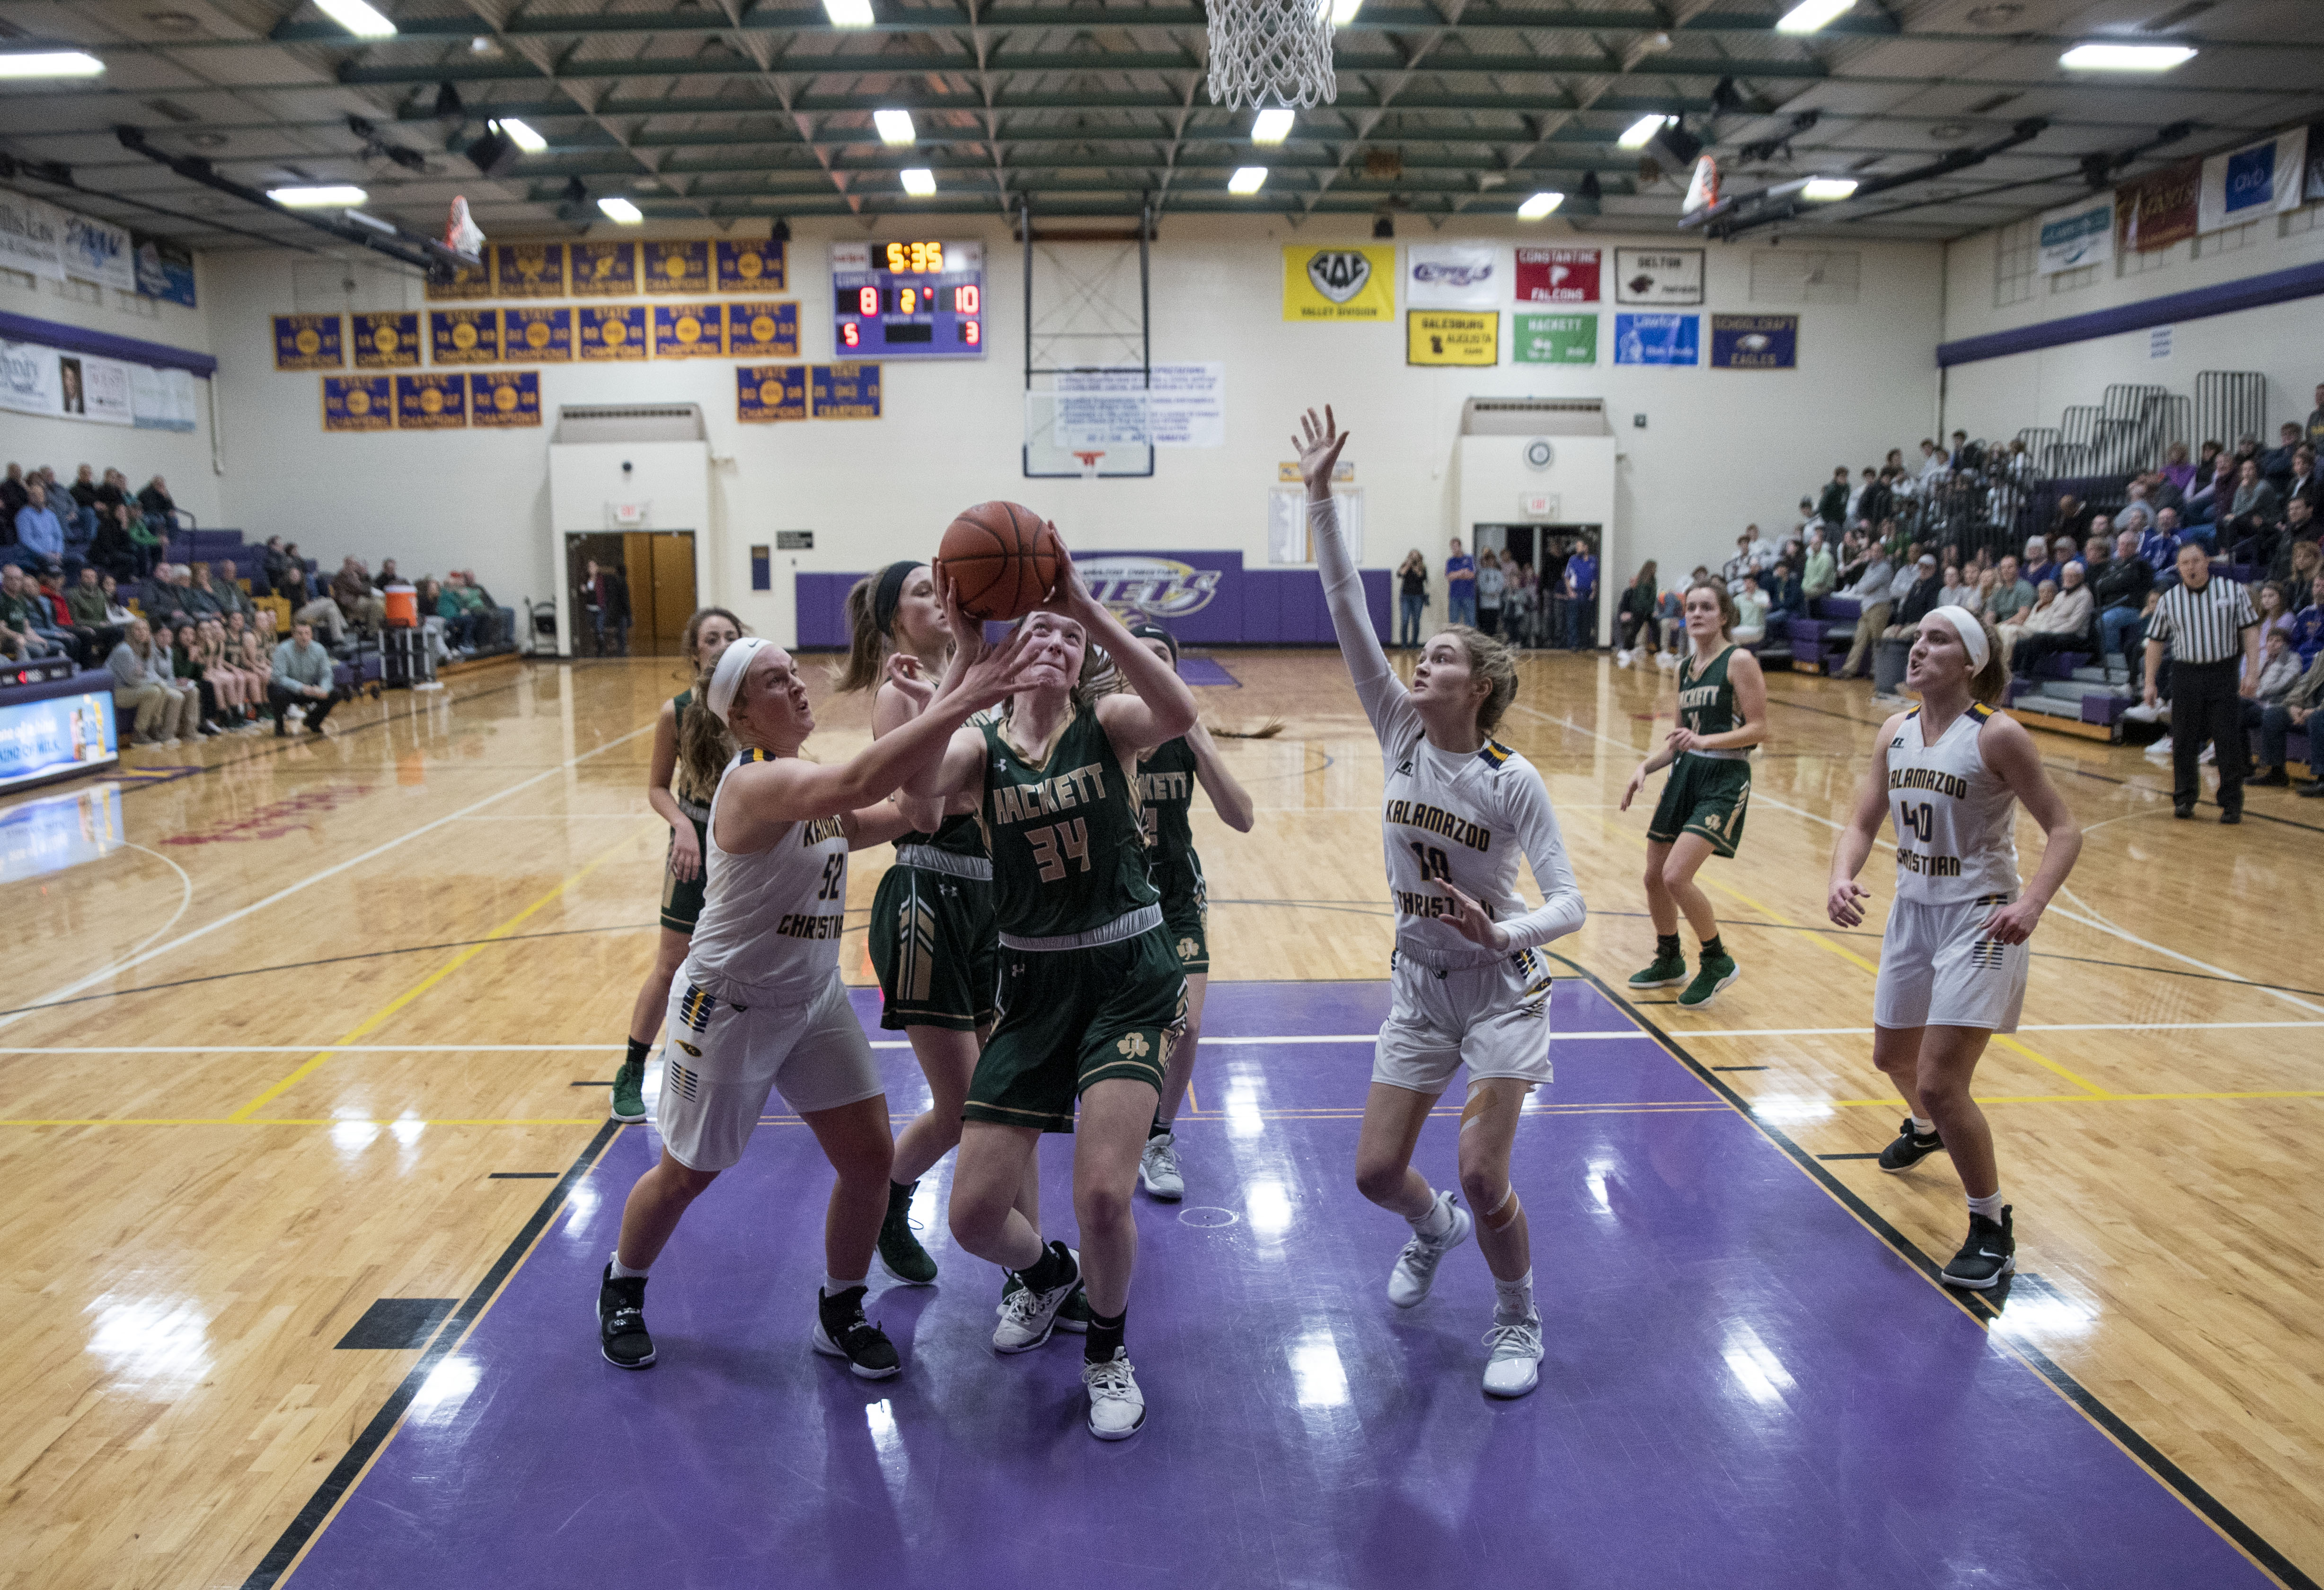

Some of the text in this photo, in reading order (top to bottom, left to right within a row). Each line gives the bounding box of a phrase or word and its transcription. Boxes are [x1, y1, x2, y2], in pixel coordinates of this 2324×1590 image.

[887, 242, 943, 274] 5:35
[860, 286, 878, 317] 8
[901, 288, 916, 314] 2
[955, 285, 980, 315] 10
[1531, 287, 1584, 301] FALCONS
[1301, 307, 1377, 316] VALLEY DIVISION
[1529, 319, 1582, 332] HACKETT
[843, 322, 859, 347] 5
[966, 321, 980, 346] 3
[1730, 352, 1776, 367] EAGLES
[1679, 685, 1719, 709] ACKETT
[993, 762, 1106, 825] HACKETT
[1138, 772, 1186, 800] KETT
[1386, 799, 1491, 852] KALAMAZOO
[1901, 801, 1932, 843] 40
[1024, 817, 1091, 883] 34
[819, 853, 844, 899] 52
[1396, 890, 1494, 920] CHRISTN
[777, 915, 844, 939] CHRISTIA
